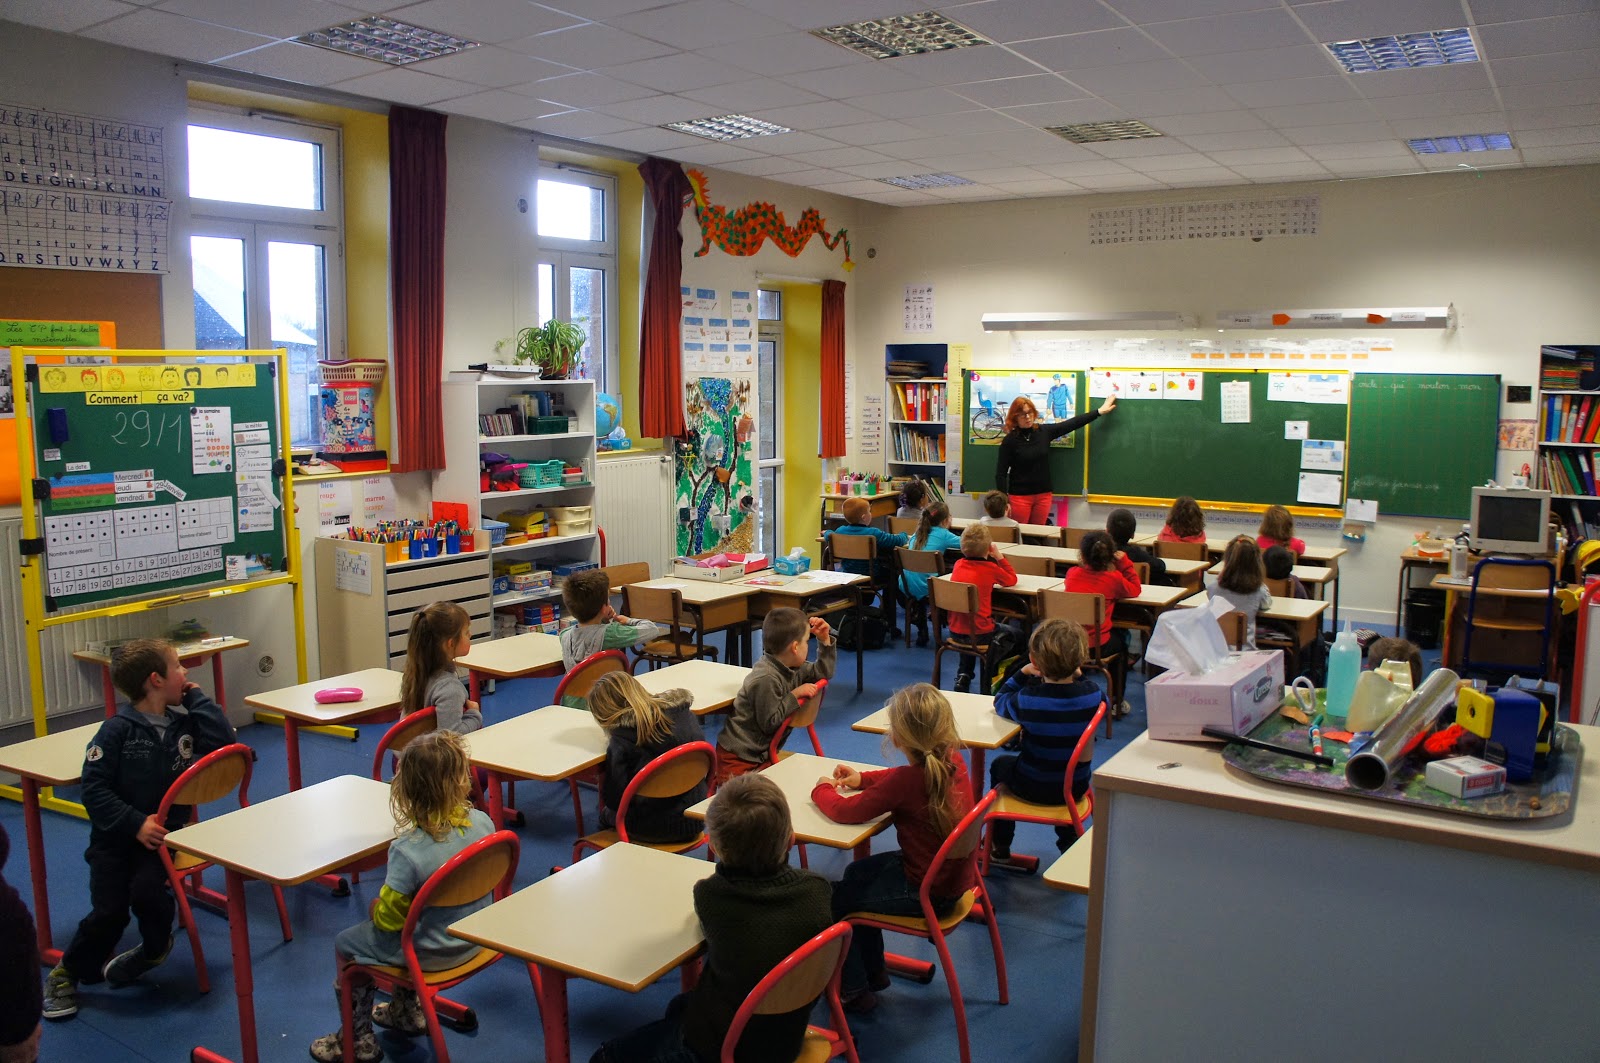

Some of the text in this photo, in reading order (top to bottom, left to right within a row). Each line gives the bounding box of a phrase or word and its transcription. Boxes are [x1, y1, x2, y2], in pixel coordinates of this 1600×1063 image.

[5, 171, 15, 181] D
[21, 173, 29, 183] E
[36, 175, 42, 183] F
[50, 176, 60, 186] G
[67, 178, 75, 188] H
[106, 183, 114, 192] K
[123, 184, 128, 193] L
[134, 185, 146, 195] M
[152, 187, 160, 196] N
[17, 254, 159, 270] R S T U V W X Y Z
[89, 392, 189, 404] Comment ça va?
[111, 410, 182, 453] 29/1
[164, 481, 184, 498] Janvier
